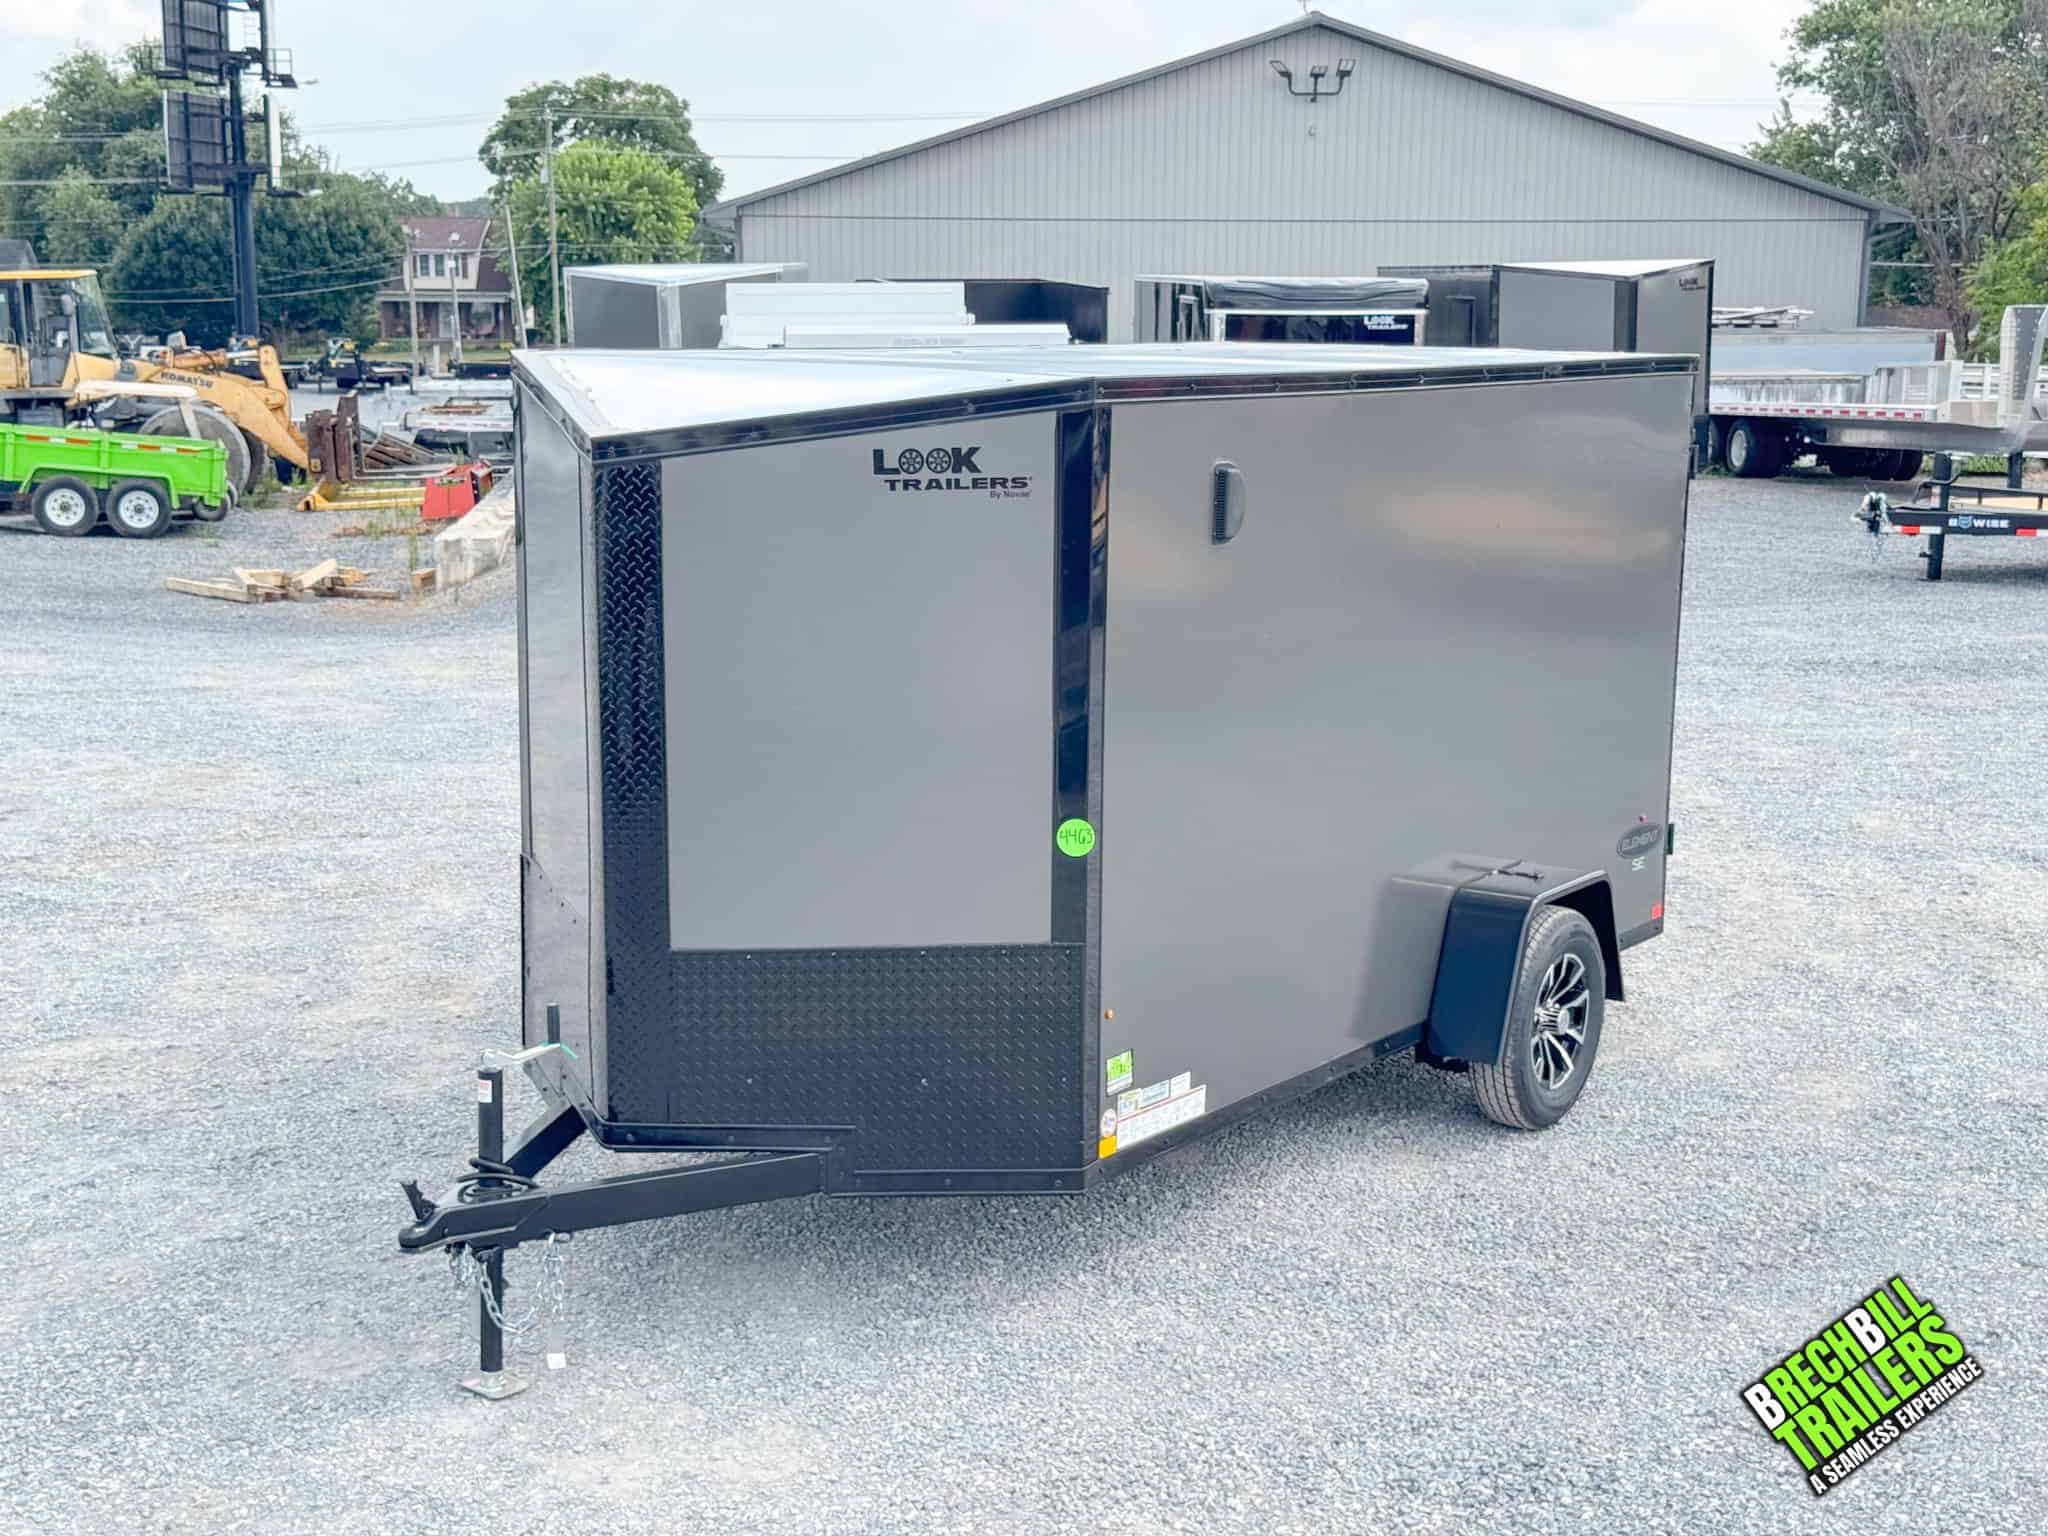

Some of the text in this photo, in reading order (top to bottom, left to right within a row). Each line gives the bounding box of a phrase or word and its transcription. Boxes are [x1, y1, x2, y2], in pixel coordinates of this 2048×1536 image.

[160, 371, 213, 388] KOMATSU
[873, 446, 983, 475] LOOK
[884, 476, 1032, 492] TRAILERS
[1631, 856, 1647, 872] SE
